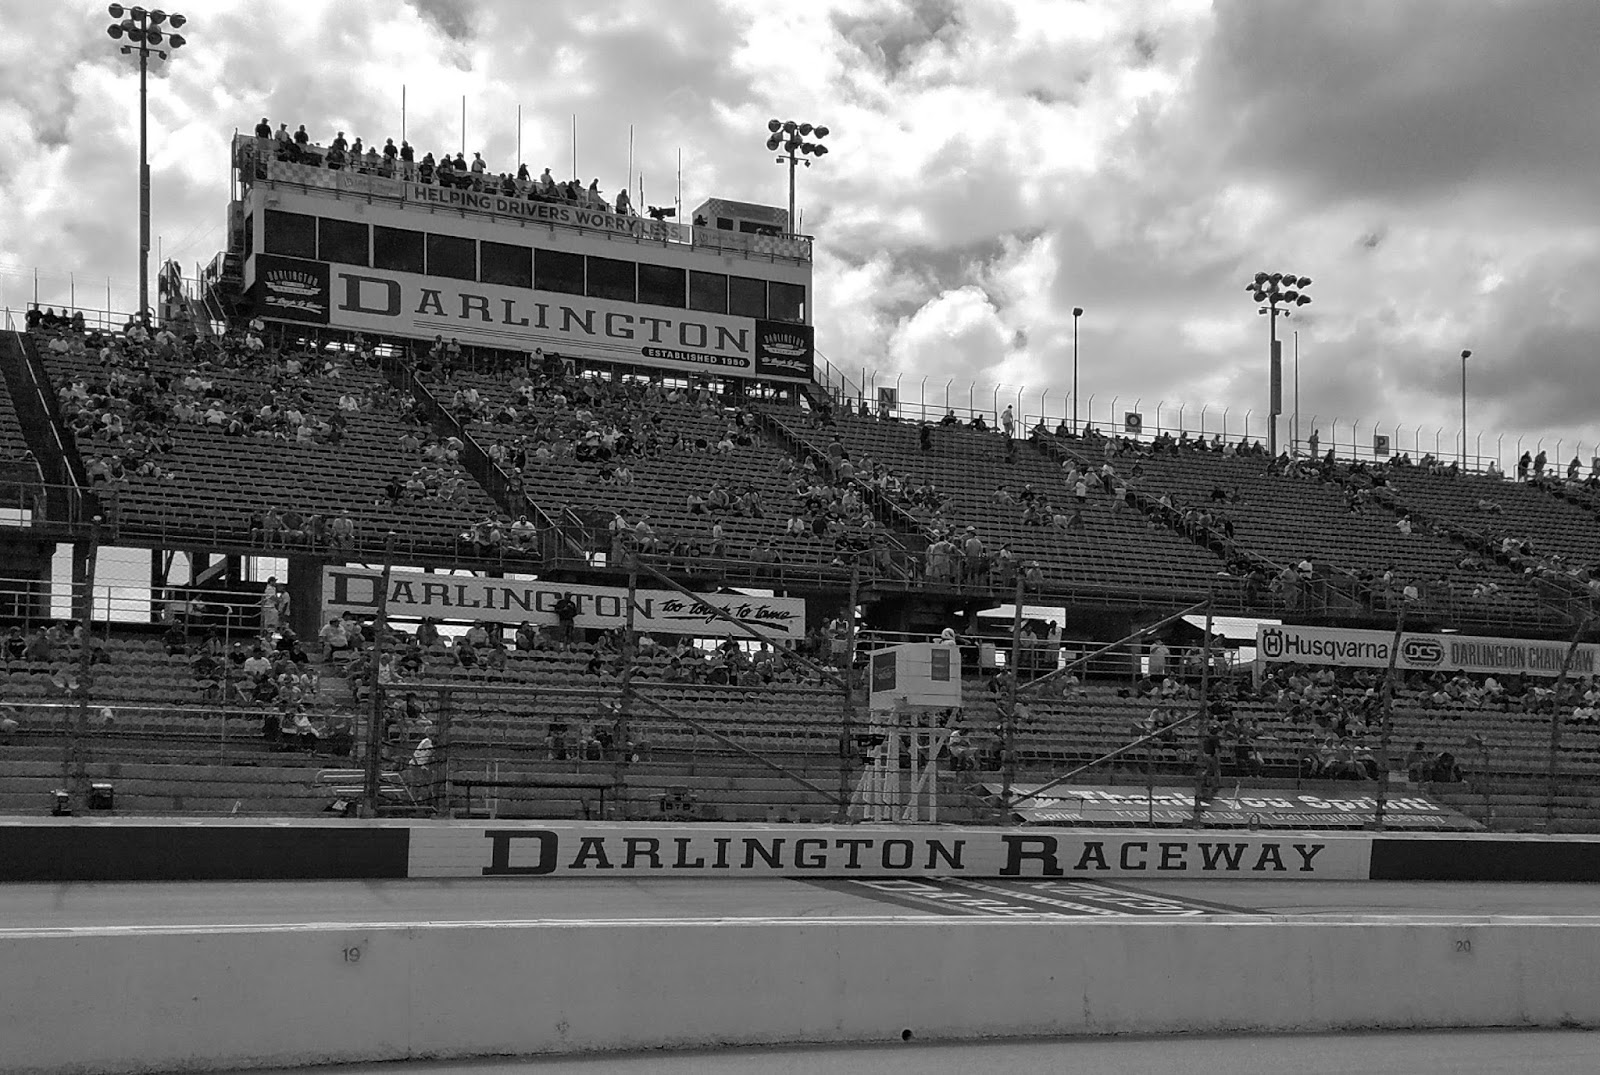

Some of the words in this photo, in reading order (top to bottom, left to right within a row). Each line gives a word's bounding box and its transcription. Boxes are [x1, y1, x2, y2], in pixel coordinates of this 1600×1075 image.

[415, 187, 491, 209] HELPING
[497, 200, 569, 220] DRIVERS
[576, 211, 636, 232] WORRY
[338, 271, 749, 353] DARLINGTON
[648, 348, 717, 364] ESTABLISHED
[328, 571, 655, 620] DARLINGTON
[658, 600, 687, 612] too
[733, 603, 752, 619] to
[755, 605, 797, 620] tame
[1285, 634, 1388, 660] Husqvarna
[1452, 642, 1526, 668] DARLINGTON
[1529, 646, 1563, 670] CHAIN
[1068, 789, 1211, 808] Thank
[482, 829, 966, 876] DARLINGTON
[1000, 835, 1326, 876] RACEWAY
[342, 947, 361, 963] 19
[1456, 940, 1471, 952] 20
